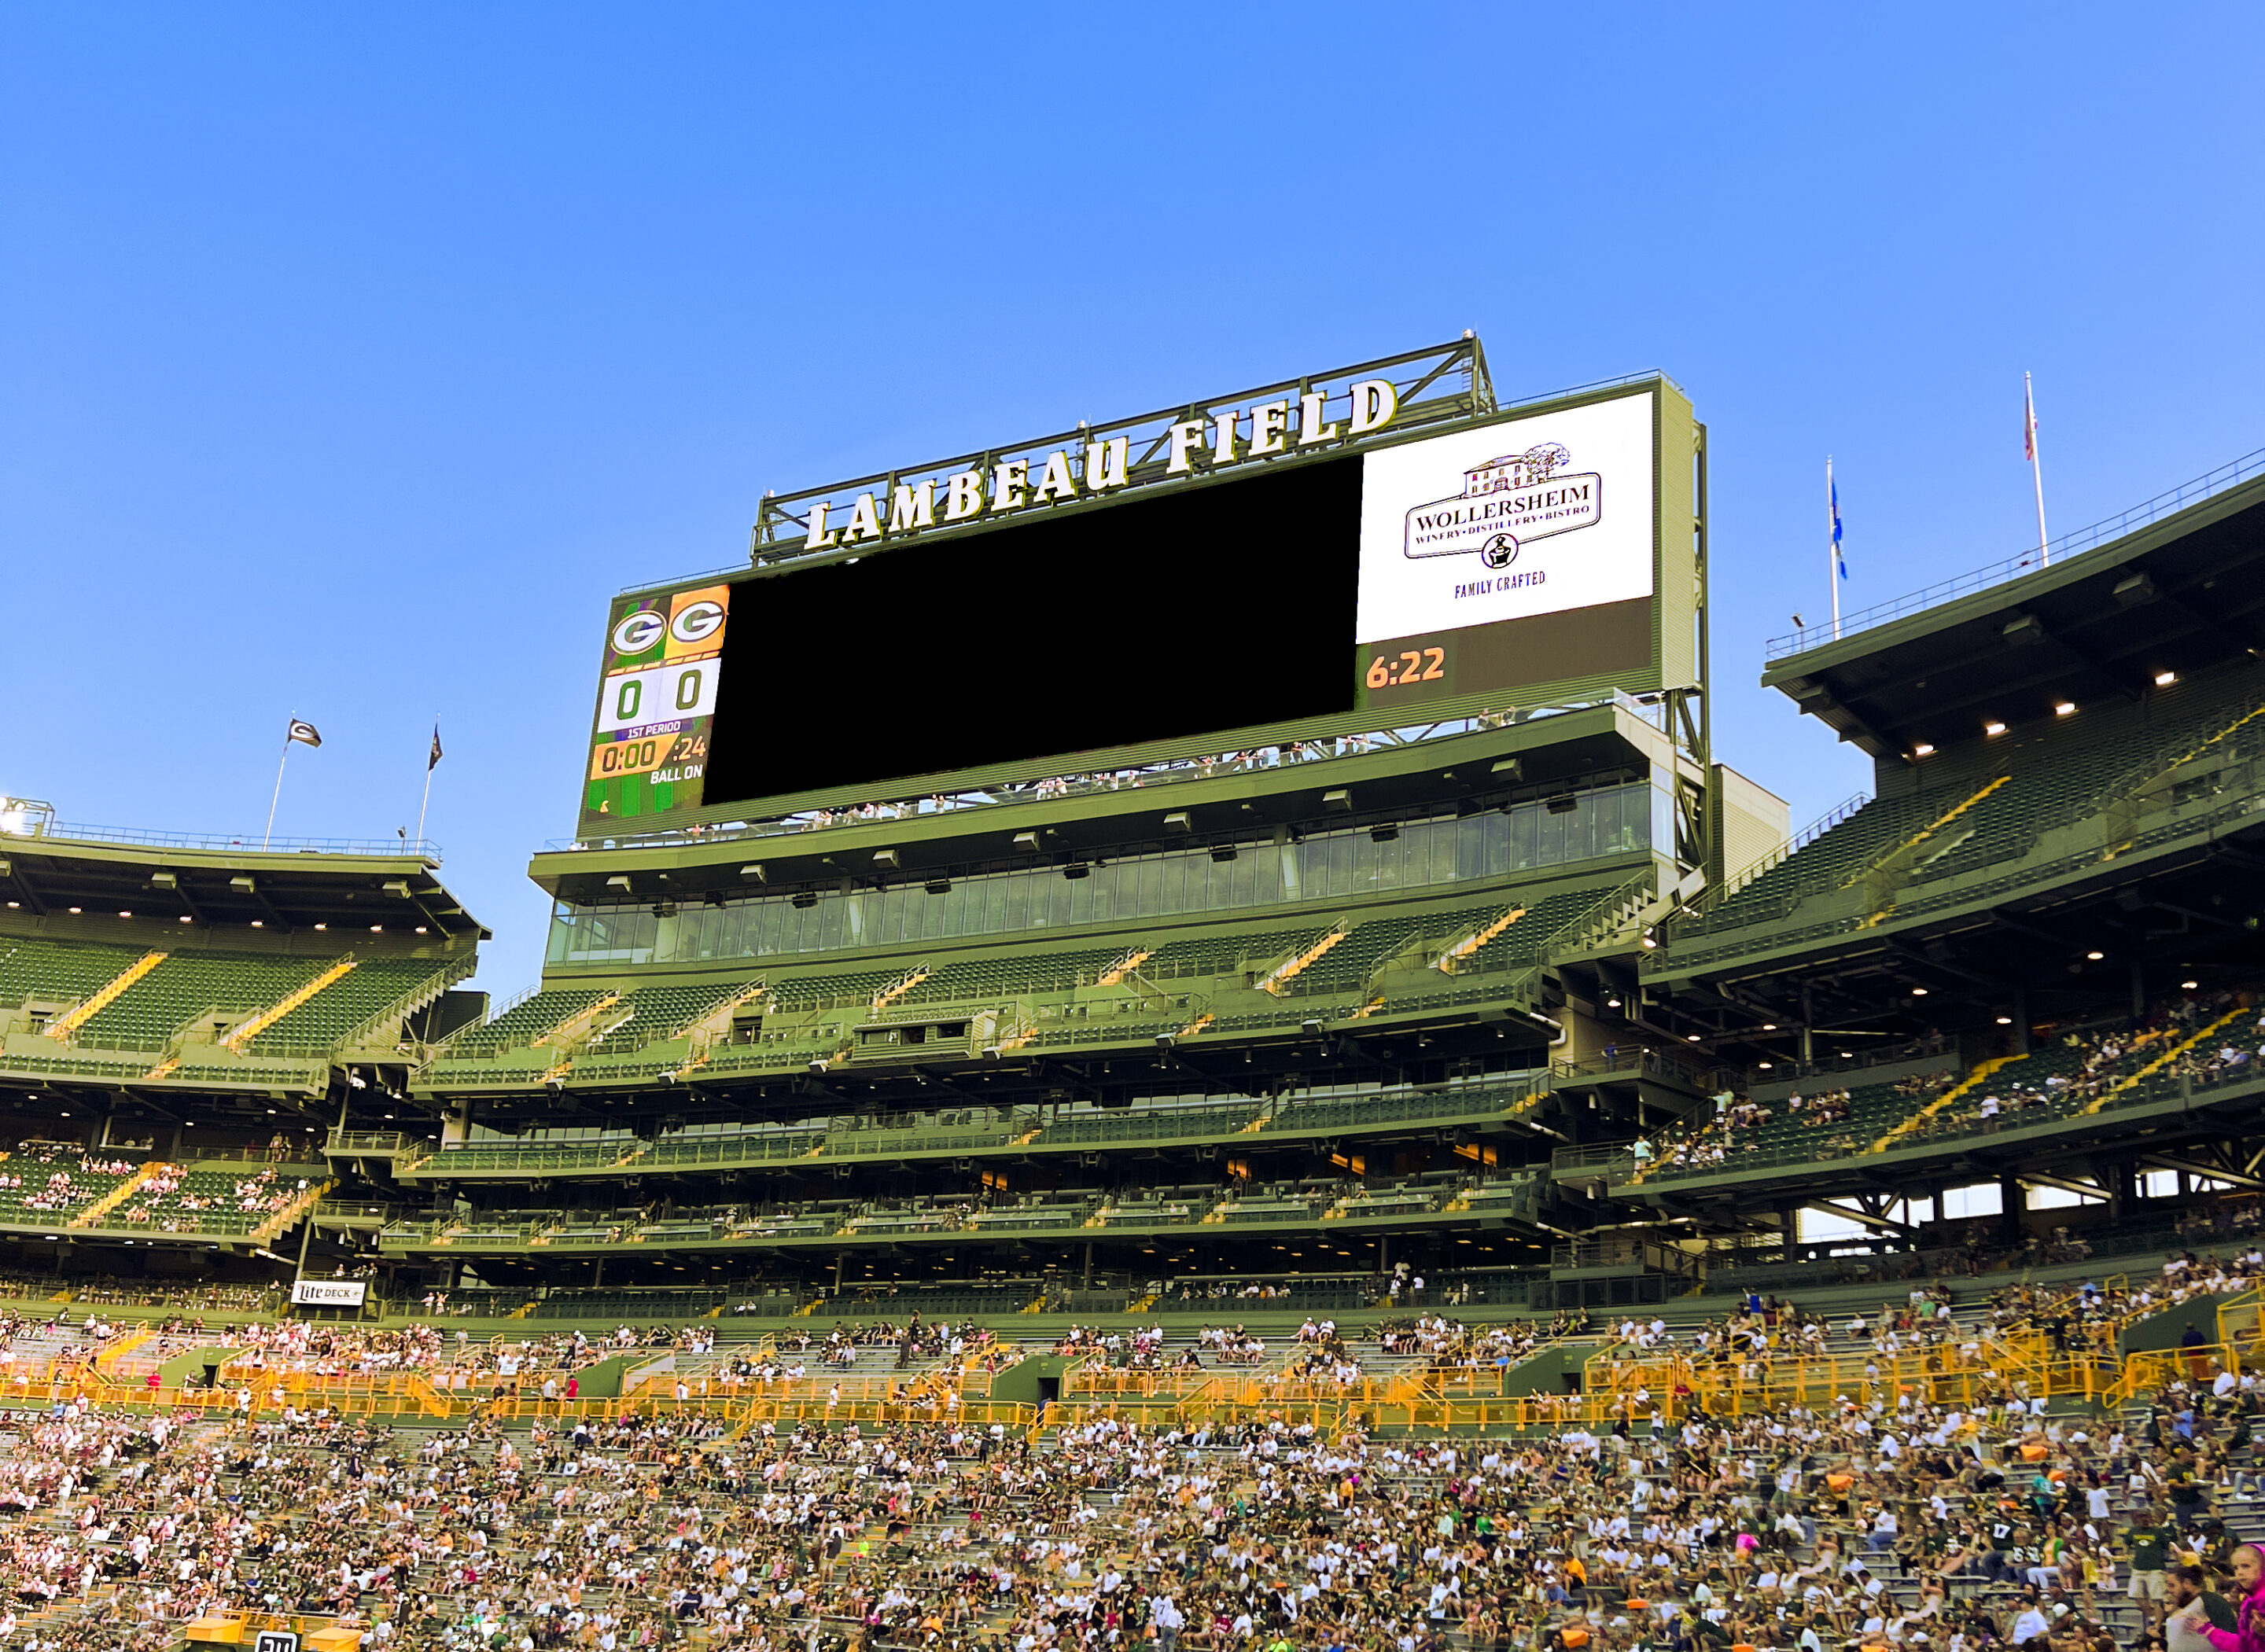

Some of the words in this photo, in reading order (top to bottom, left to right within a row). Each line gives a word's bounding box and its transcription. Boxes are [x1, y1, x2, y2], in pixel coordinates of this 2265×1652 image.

[803, 435, 1130, 552] LAMBEAU
[1166, 378, 1400, 475] FIELD
[1416, 484, 1589, 532] WOLLERSHEIM
[1455, 579, 1493, 599] FAMILY
[1497, 570, 1546, 592] CRAFTED
[1365, 647, 1446, 689] 6:22
[617, 679, 642, 721] 0
[676, 668, 702, 710] 0
[628, 727, 646, 739] 1ST
[646, 720, 682, 737] PERIOD
[602, 740, 656, 773] 0:00
[650, 768, 682, 786] BALL
[683, 763, 704, 781] ON
[299, 1284, 323, 1302] Lite
[324, 1289, 351, 1298] DECK
